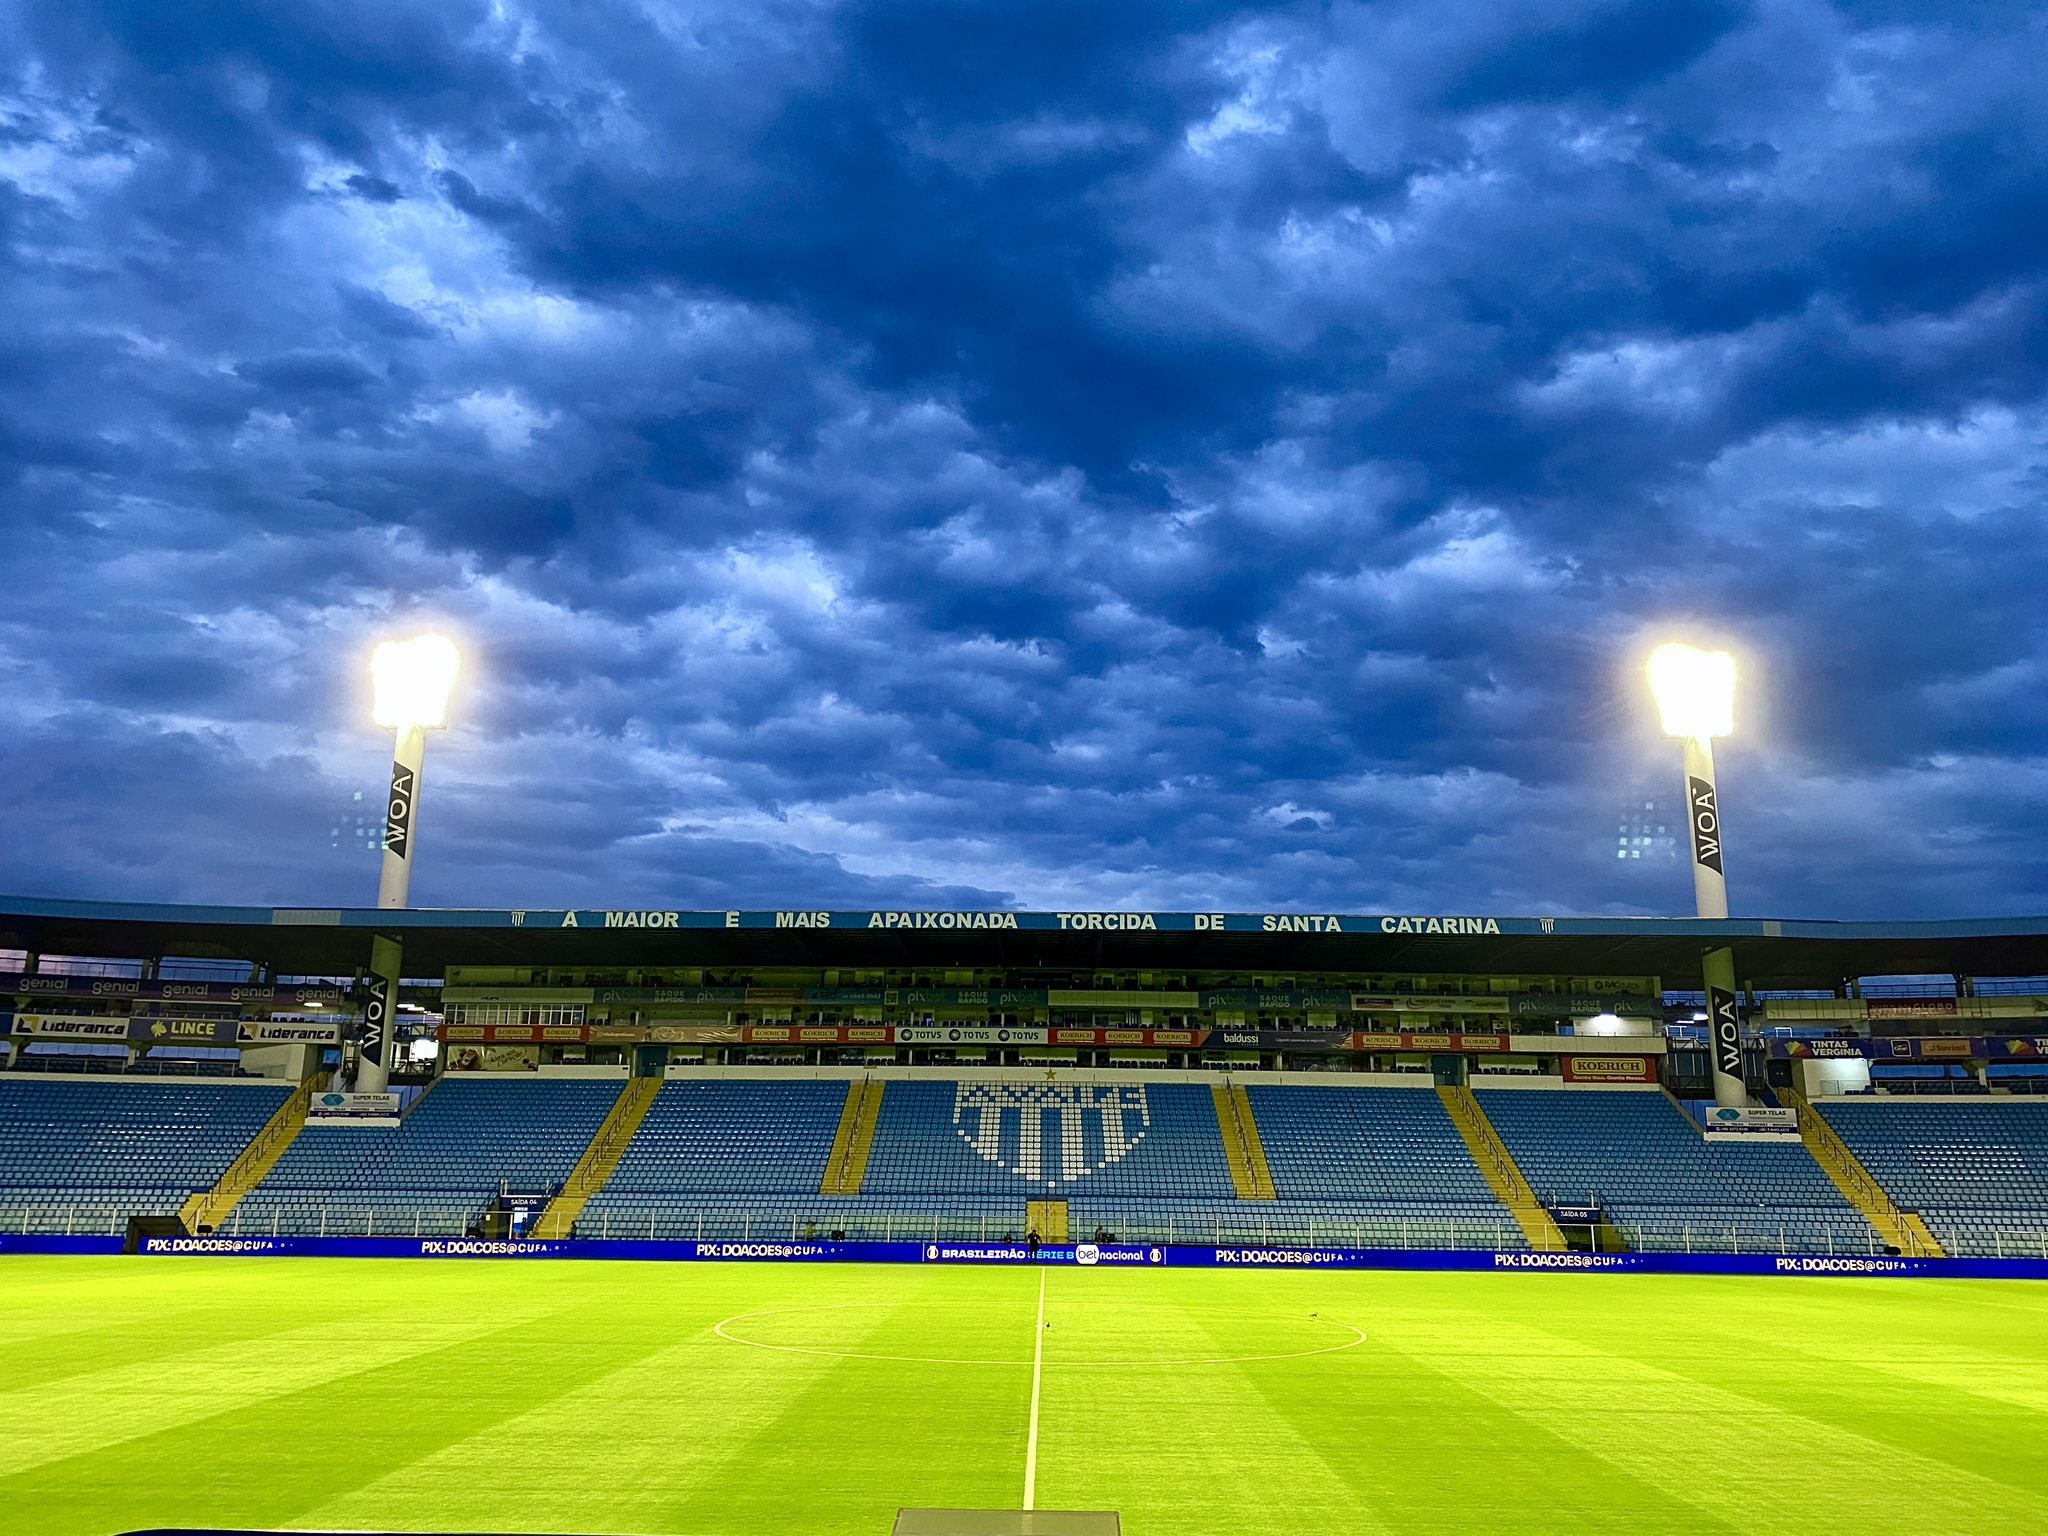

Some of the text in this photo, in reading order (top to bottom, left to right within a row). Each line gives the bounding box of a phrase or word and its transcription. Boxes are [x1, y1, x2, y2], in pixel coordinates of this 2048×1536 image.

[386, 774, 412, 845] WOA
[1696, 791, 1719, 861] WOA
[561, 911, 1501, 935] A MAIOR E MAIS APAIXONADA TORCIDA DE SANTA CATARINA
[18, 977, 70, 992] genial
[91, 980, 140, 995] genial
[161, 984, 209, 998] genial
[230, 986, 275, 1000] genial
[296, 988, 339, 1001] genial
[363, 979, 387, 1050] WOA
[171, 1021, 216, 1035] LINCE
[915, 1031, 942, 1039] TOTVS
[963, 1031, 990, 1039] TOTVS
[1012, 1031, 1039, 1040] TOTVS
[1223, 1033, 1259, 1044] baldussi
[1719, 1000, 1740, 1071] WOA
[1810, 1040, 1849, 1048] TINTAS
[1811, 1048, 1863, 1056] VERGINIA
[1577, 1061, 1641, 1071] KOERICH
[147, 1239, 172, 1251] PIX:
[421, 1241, 446, 1254] PIX:
[696, 1244, 720, 1256] PIX:
[941, 1248, 1026, 1259] BRASILEIRÃO
[1066, 1250, 1075, 1259] B
[1215, 1250, 1240, 1262] PIX:
[1494, 1254, 1519, 1266] PIX:
[1776, 1258, 1801, 1271] PIX:
